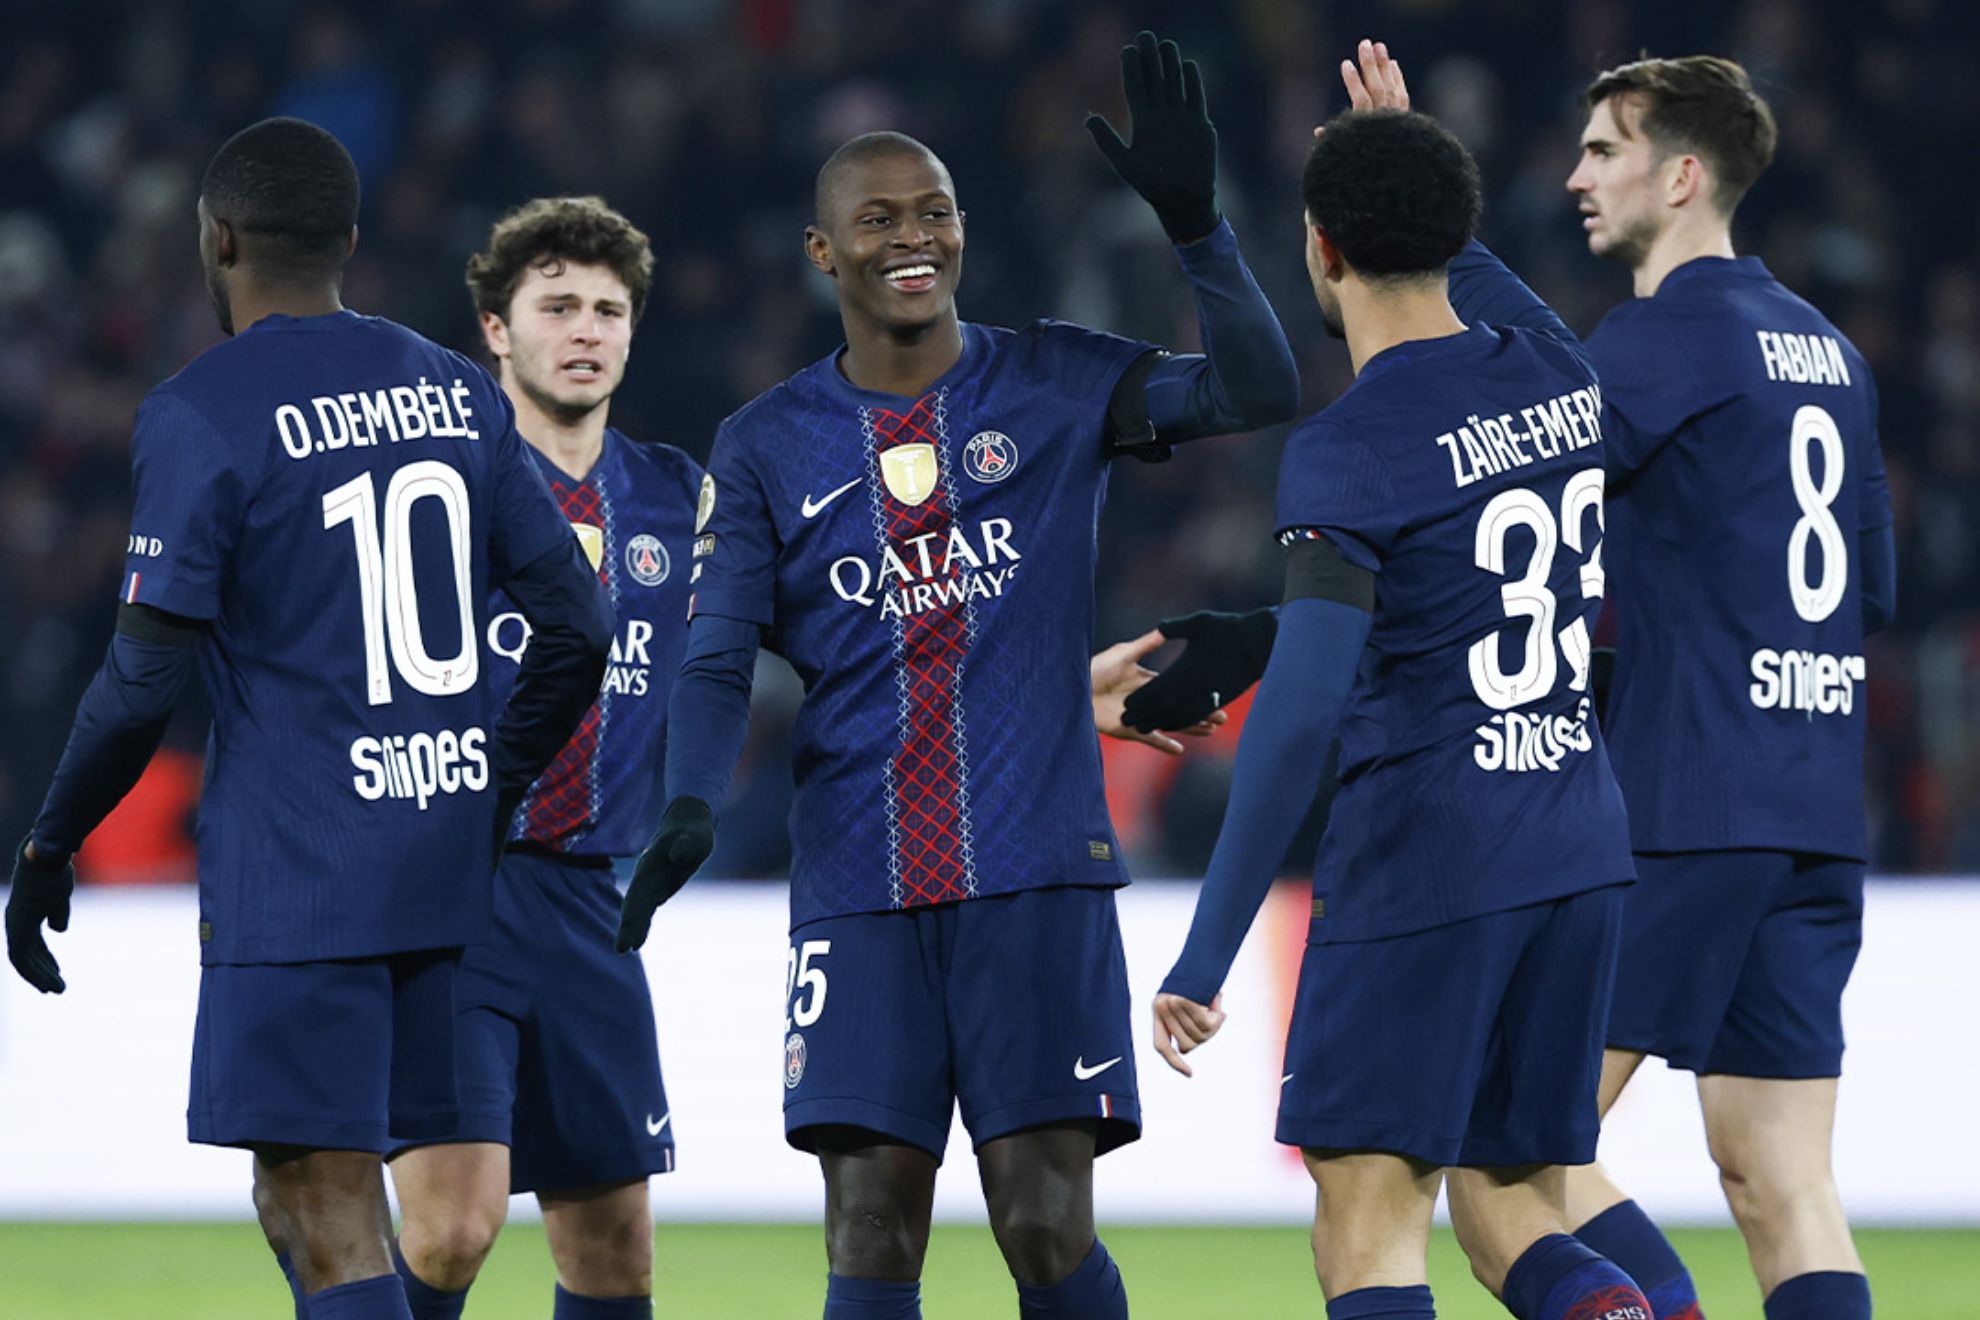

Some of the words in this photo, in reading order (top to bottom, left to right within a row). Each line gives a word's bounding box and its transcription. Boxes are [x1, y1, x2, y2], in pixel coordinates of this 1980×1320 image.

[1756, 330, 1851, 387] FABIAN
[1787, 404, 1848, 623] 8
[322, 459, 480, 706] 10
[829, 517, 1023, 608] QATAR
[349, 726, 489, 811] snipes
